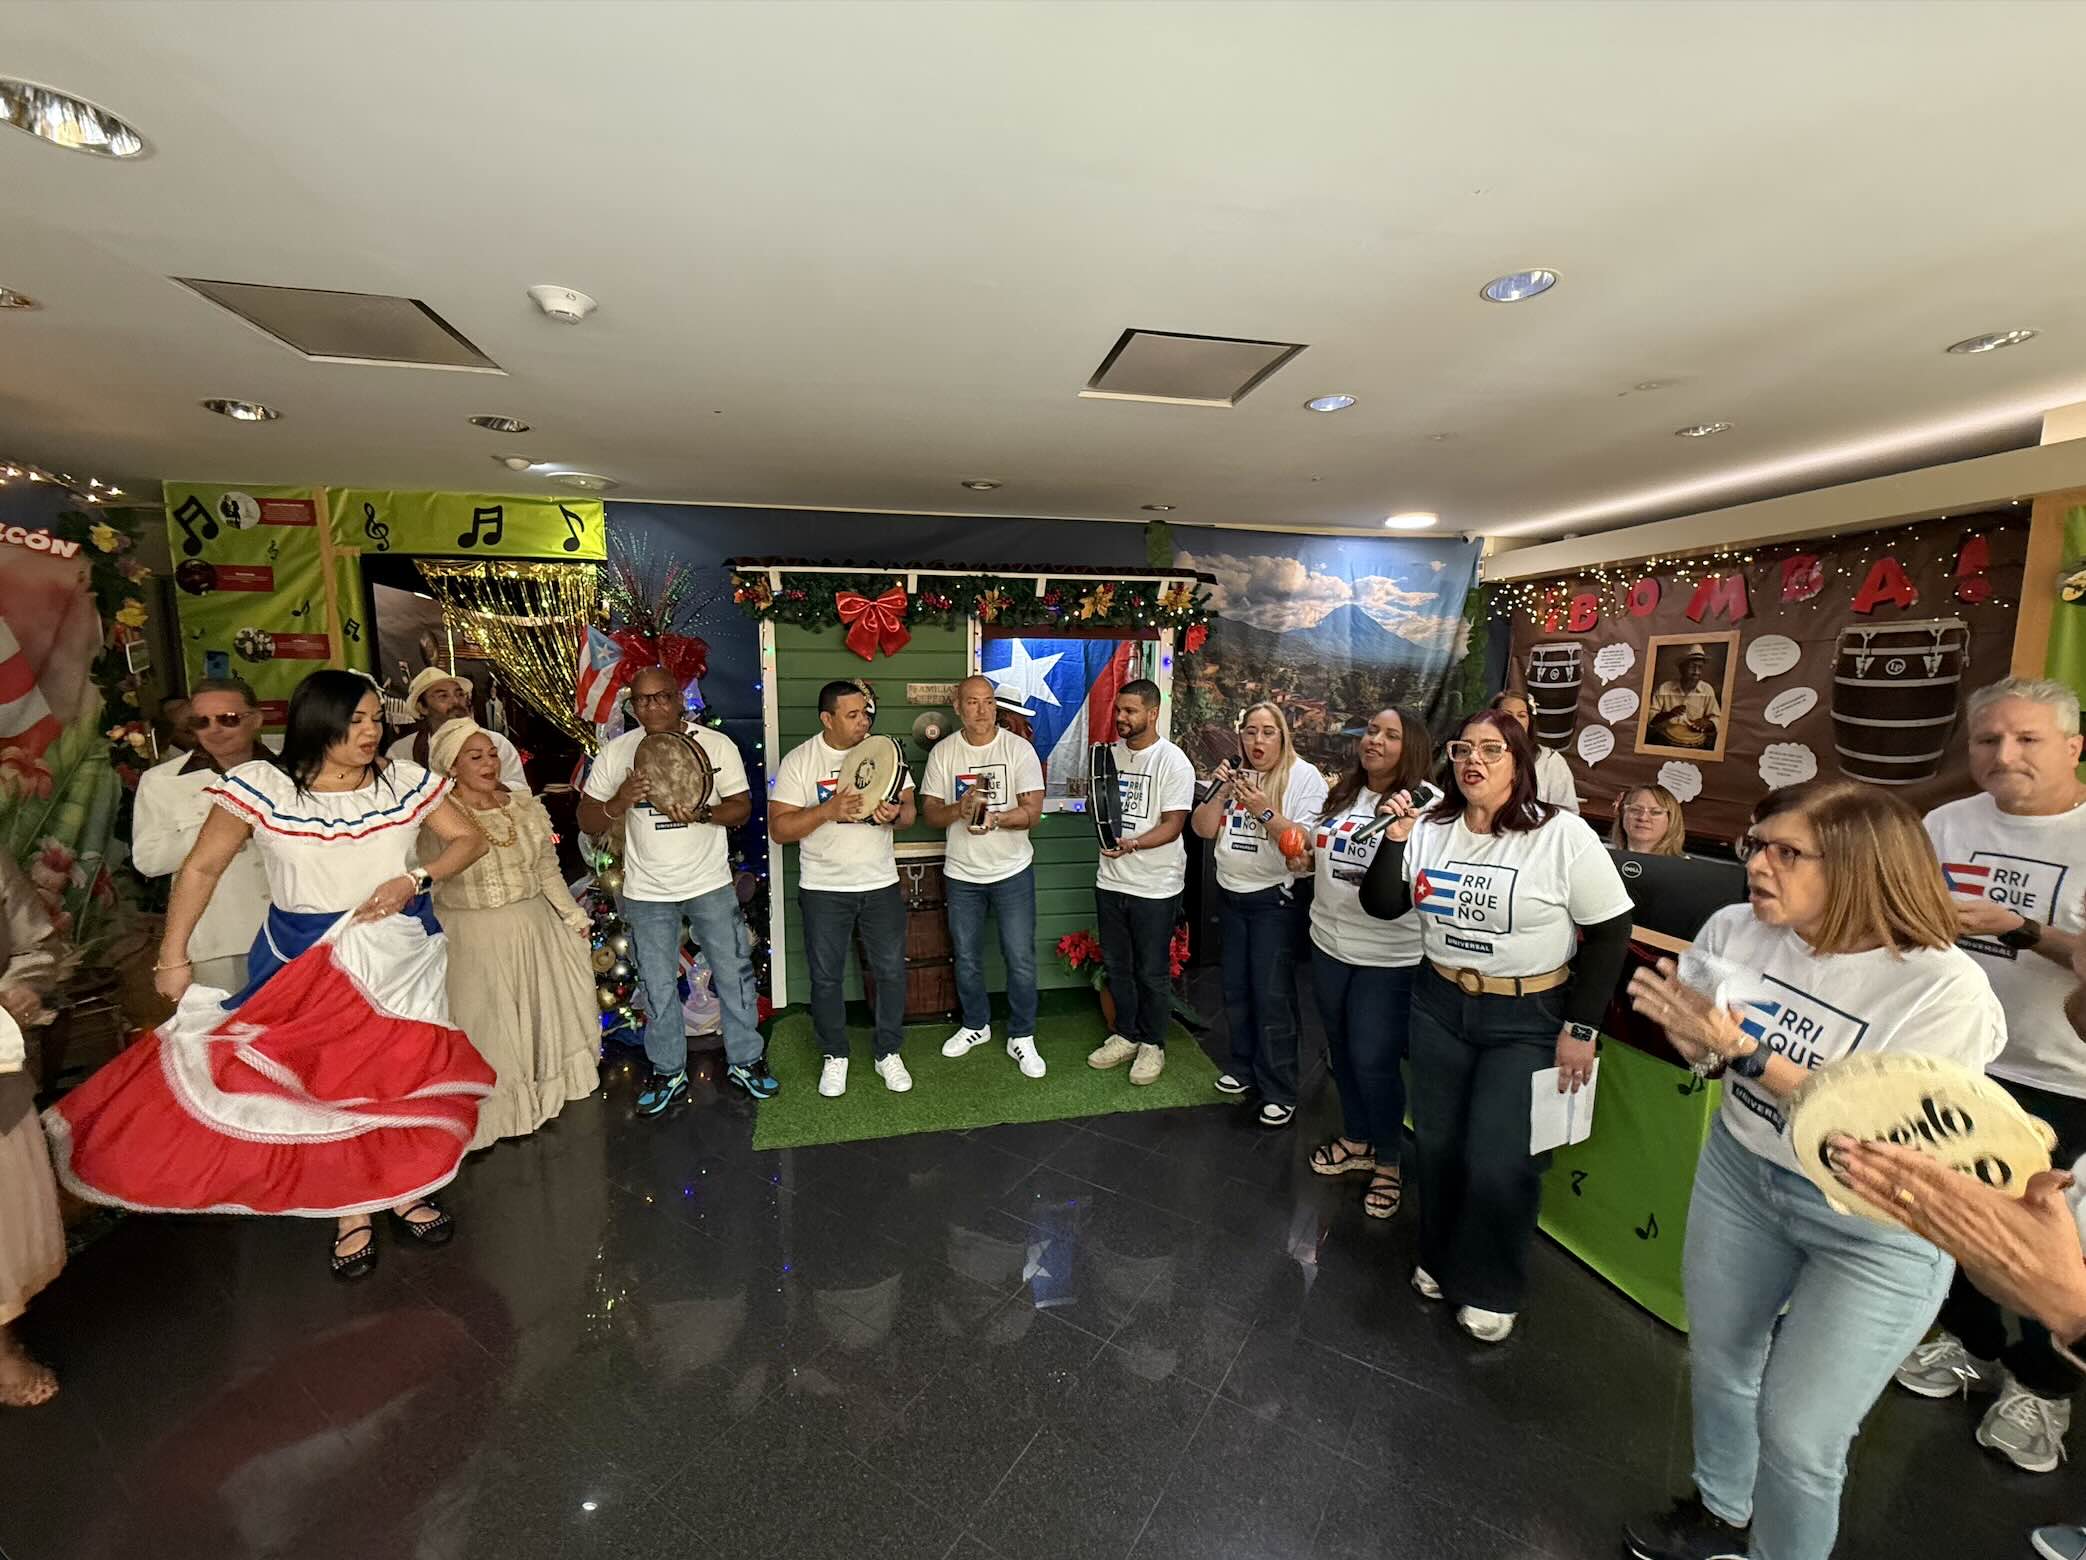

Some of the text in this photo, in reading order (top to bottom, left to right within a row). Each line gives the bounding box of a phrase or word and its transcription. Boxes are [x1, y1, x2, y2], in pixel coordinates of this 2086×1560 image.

[1348, 843, 1367, 858] ÑO
[1463, 875, 1492, 890] RRI
[1993, 868, 2030, 888] RRI
[1459, 891, 1498, 909] QUE
[1988, 887, 2037, 909] QUE
[1458, 904, 1486, 922] ÑO
[1447, 937, 1491, 952] UNIVERSAL
[1779, 1008, 1824, 1044] RRI
[1767, 1032, 1825, 1071] QUE
